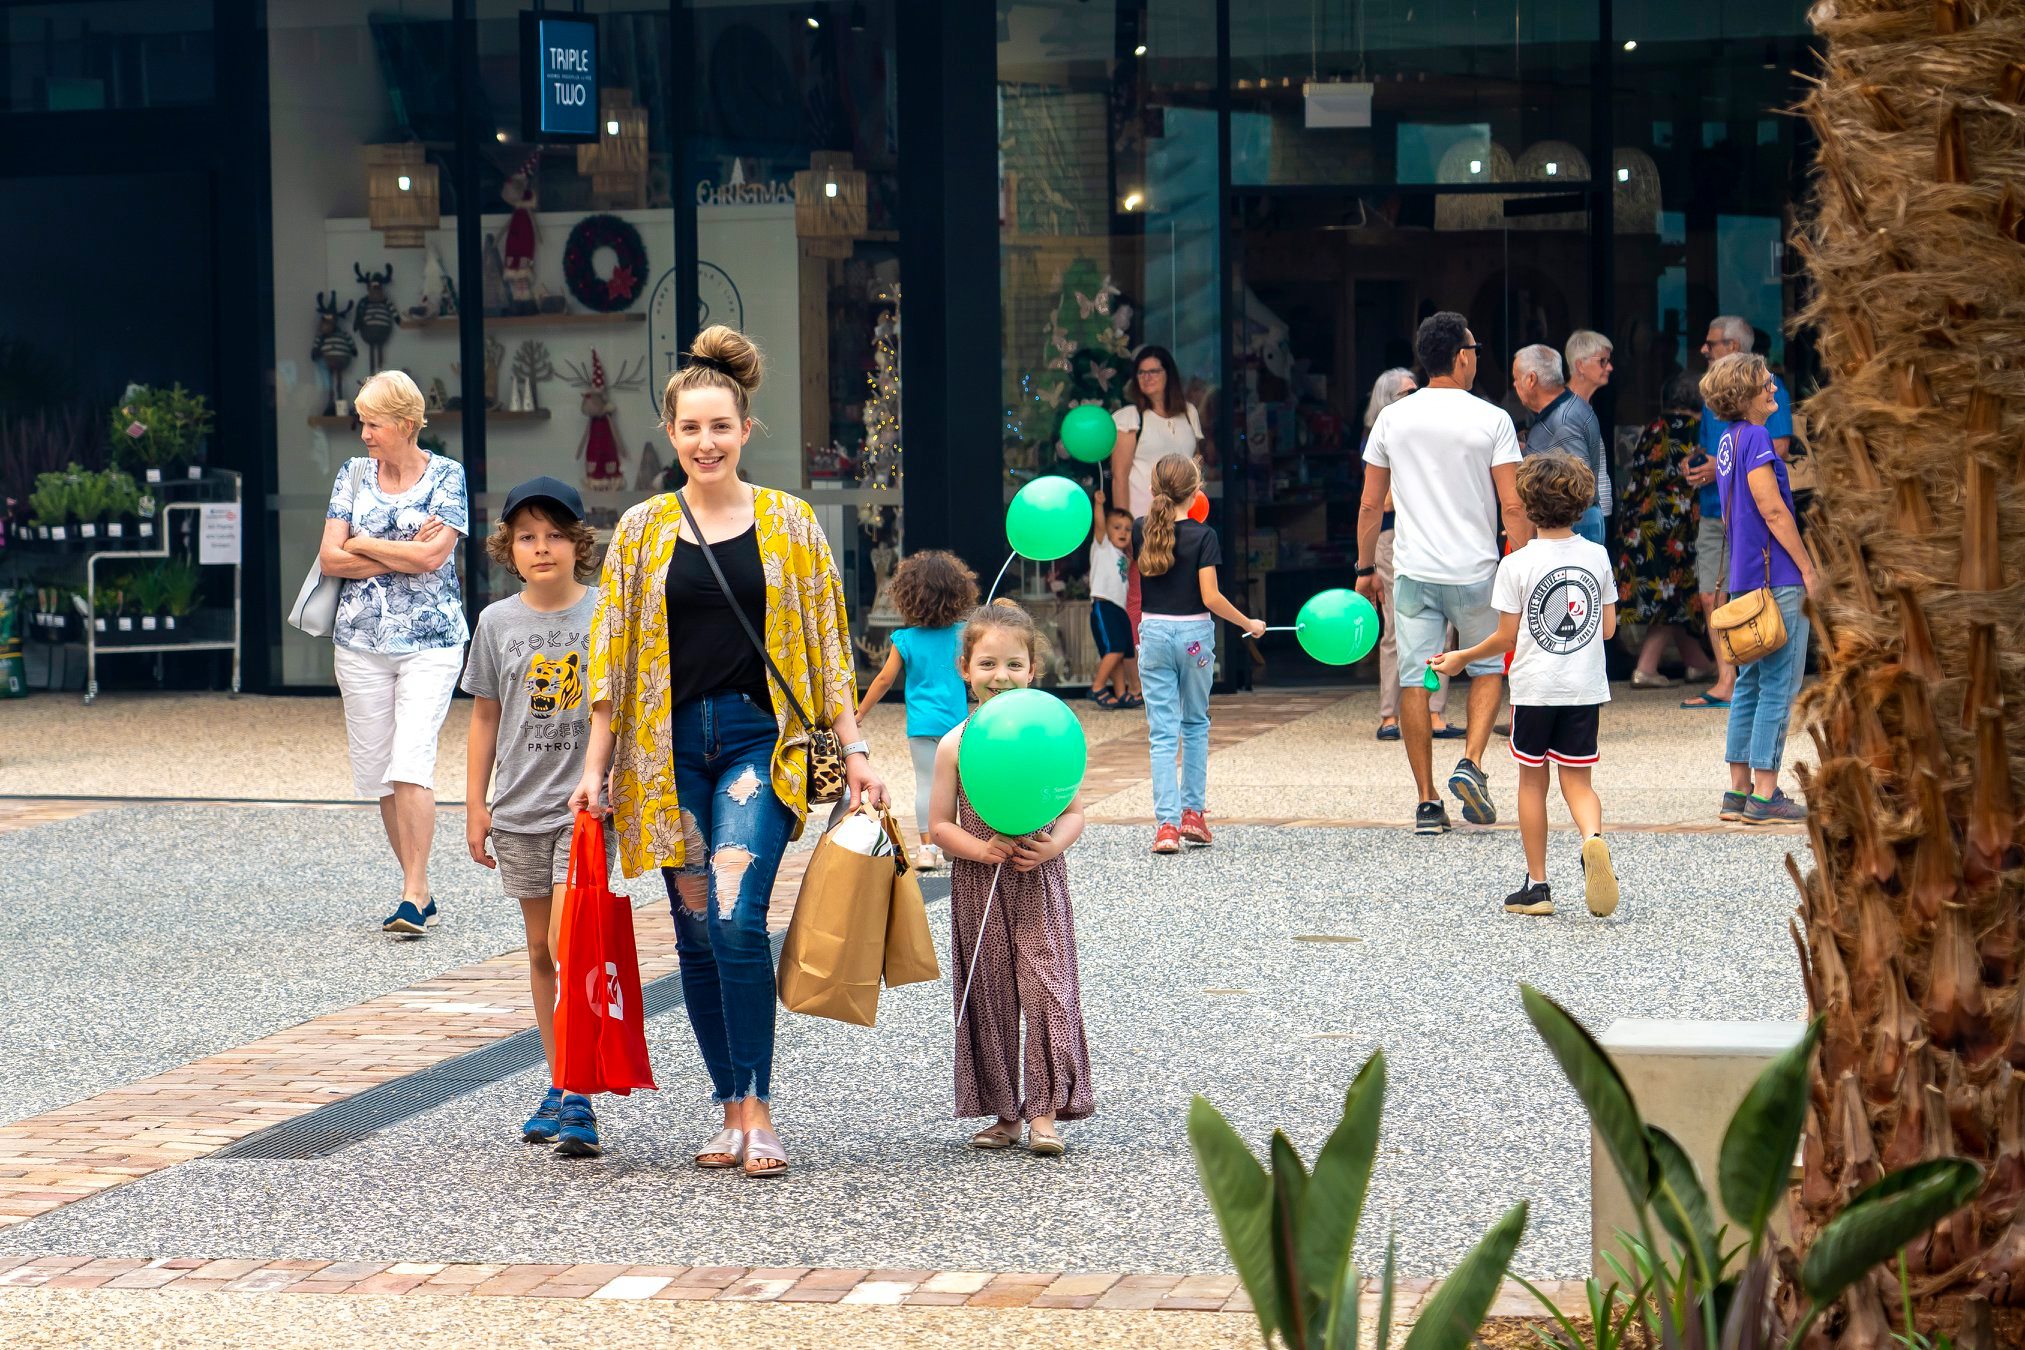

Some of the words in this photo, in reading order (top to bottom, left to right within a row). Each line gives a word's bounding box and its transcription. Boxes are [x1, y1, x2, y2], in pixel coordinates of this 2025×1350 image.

[549, 47, 589, 72] TRIPLE
[554, 82, 586, 106] TWO
[1534, 574, 1556, 601] SURVIVE
[1580, 574, 1597, 594] FORTUNE
[1530, 601, 1539, 626] BRAVE
[1532, 625, 1543, 639] THE
[1577, 629, 1592, 644] BRAVE
[1540, 636, 1557, 651] ONLY
[520, 719, 585, 739] TIGER
[528, 741, 579, 752] PATROL
